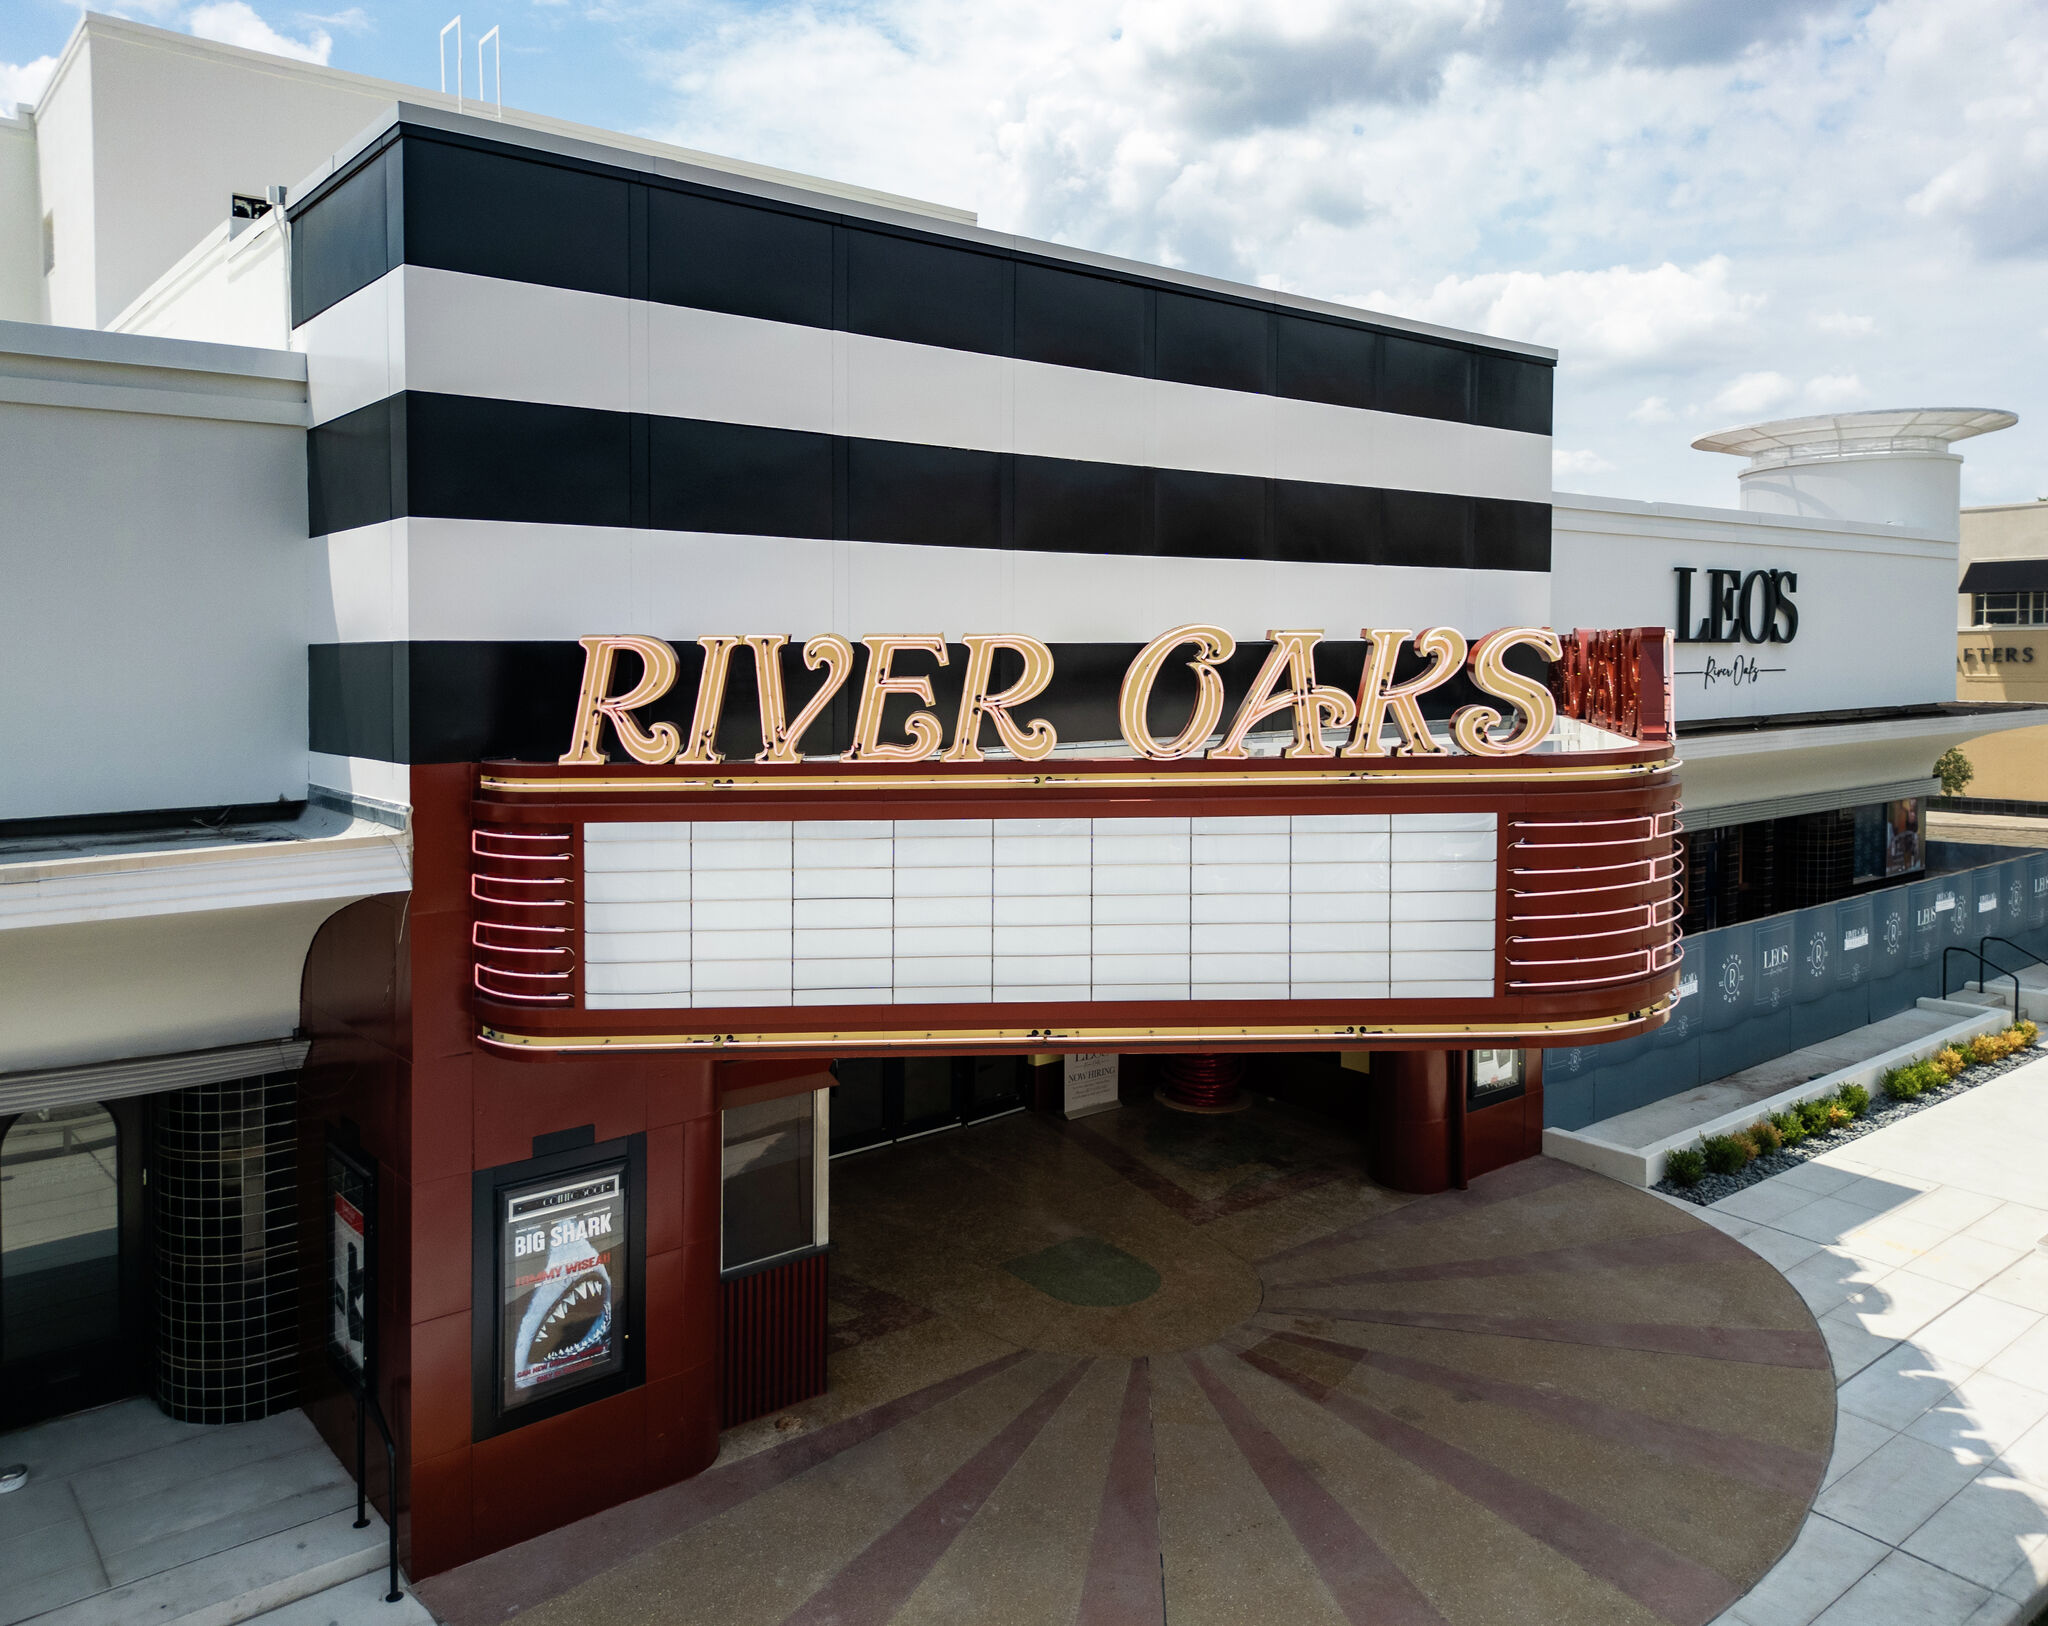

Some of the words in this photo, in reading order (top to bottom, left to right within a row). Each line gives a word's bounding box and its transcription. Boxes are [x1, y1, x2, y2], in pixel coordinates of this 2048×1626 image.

[1674, 567, 1798, 644] LEO'S
[1957, 647, 2034, 663] FTERS
[1704, 655, 1733, 690] River
[1733, 655, 1759, 686] Oaks
[558, 633, 1058, 766] RIVER
[1118, 623, 1564, 761] OAKS
[1729, 968, 1736, 989] R
[1087, 1066, 1116, 1079] HIRING
[514, 1230, 546, 1258] BIG
[550, 1212, 612, 1247] SHARK
[565, 1252, 611, 1275] WISEAU
